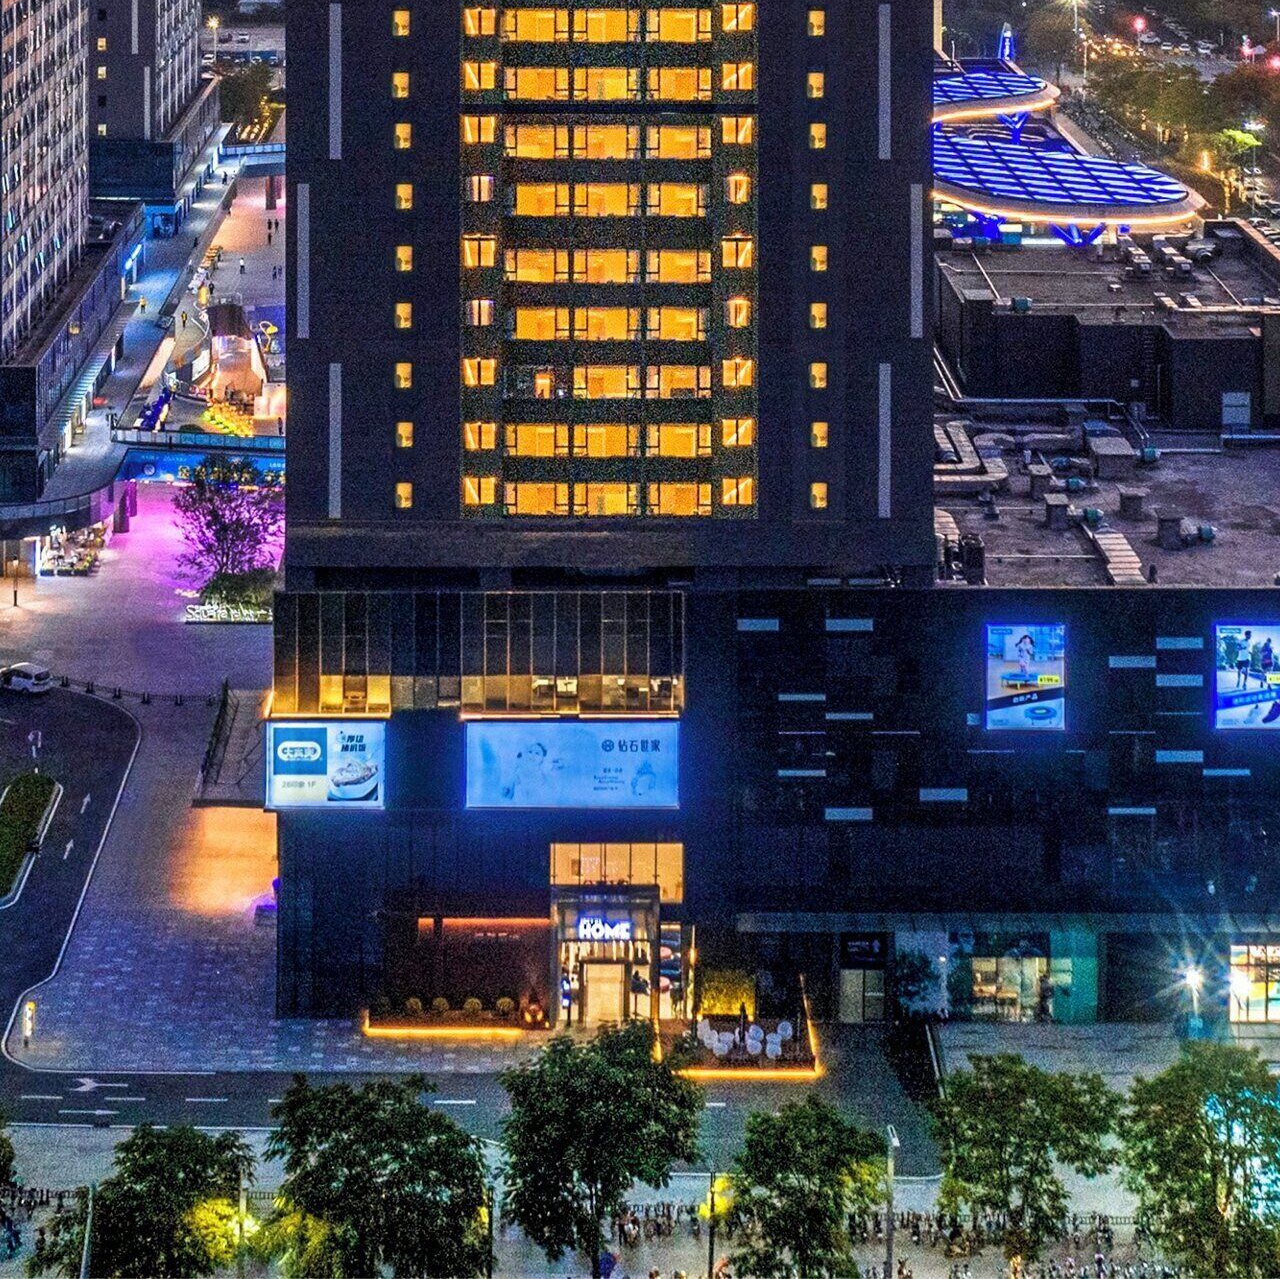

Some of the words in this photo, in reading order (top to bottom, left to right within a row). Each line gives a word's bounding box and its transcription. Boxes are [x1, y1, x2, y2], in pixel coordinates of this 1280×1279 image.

[618, 739, 661, 753] 钻石世家
[579, 920, 631, 940] HOME
